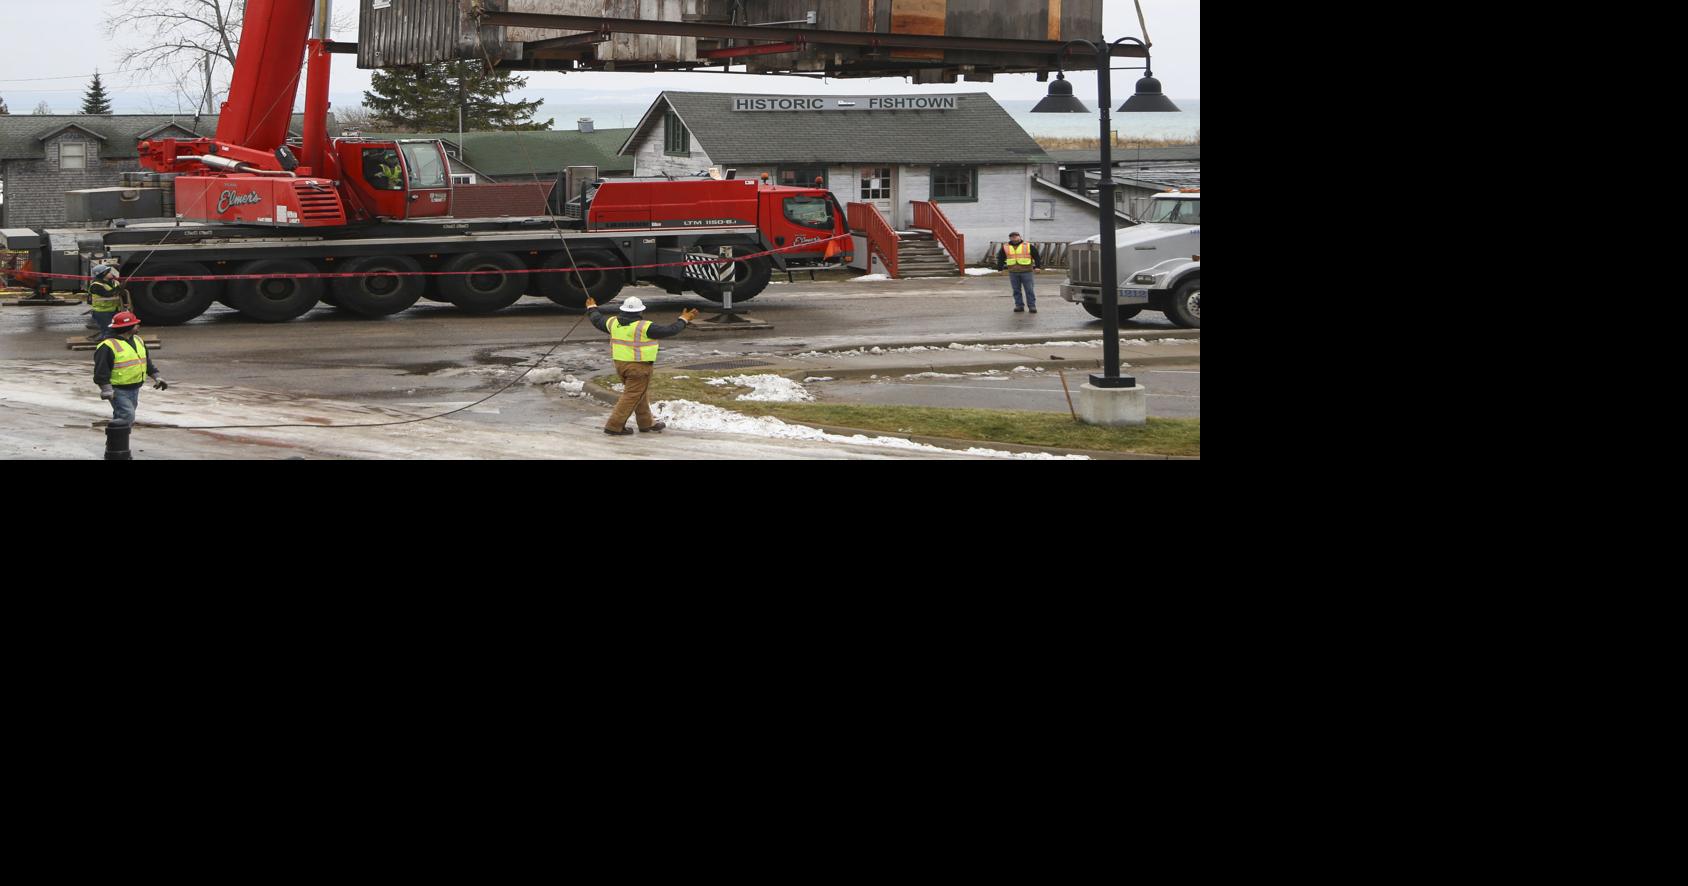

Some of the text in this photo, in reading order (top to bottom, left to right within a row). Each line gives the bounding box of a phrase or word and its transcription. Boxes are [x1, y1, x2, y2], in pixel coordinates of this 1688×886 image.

[736, 97, 954, 110] HISTORIC FISHTOWN
[216, 189, 262, 215] Elmer's
